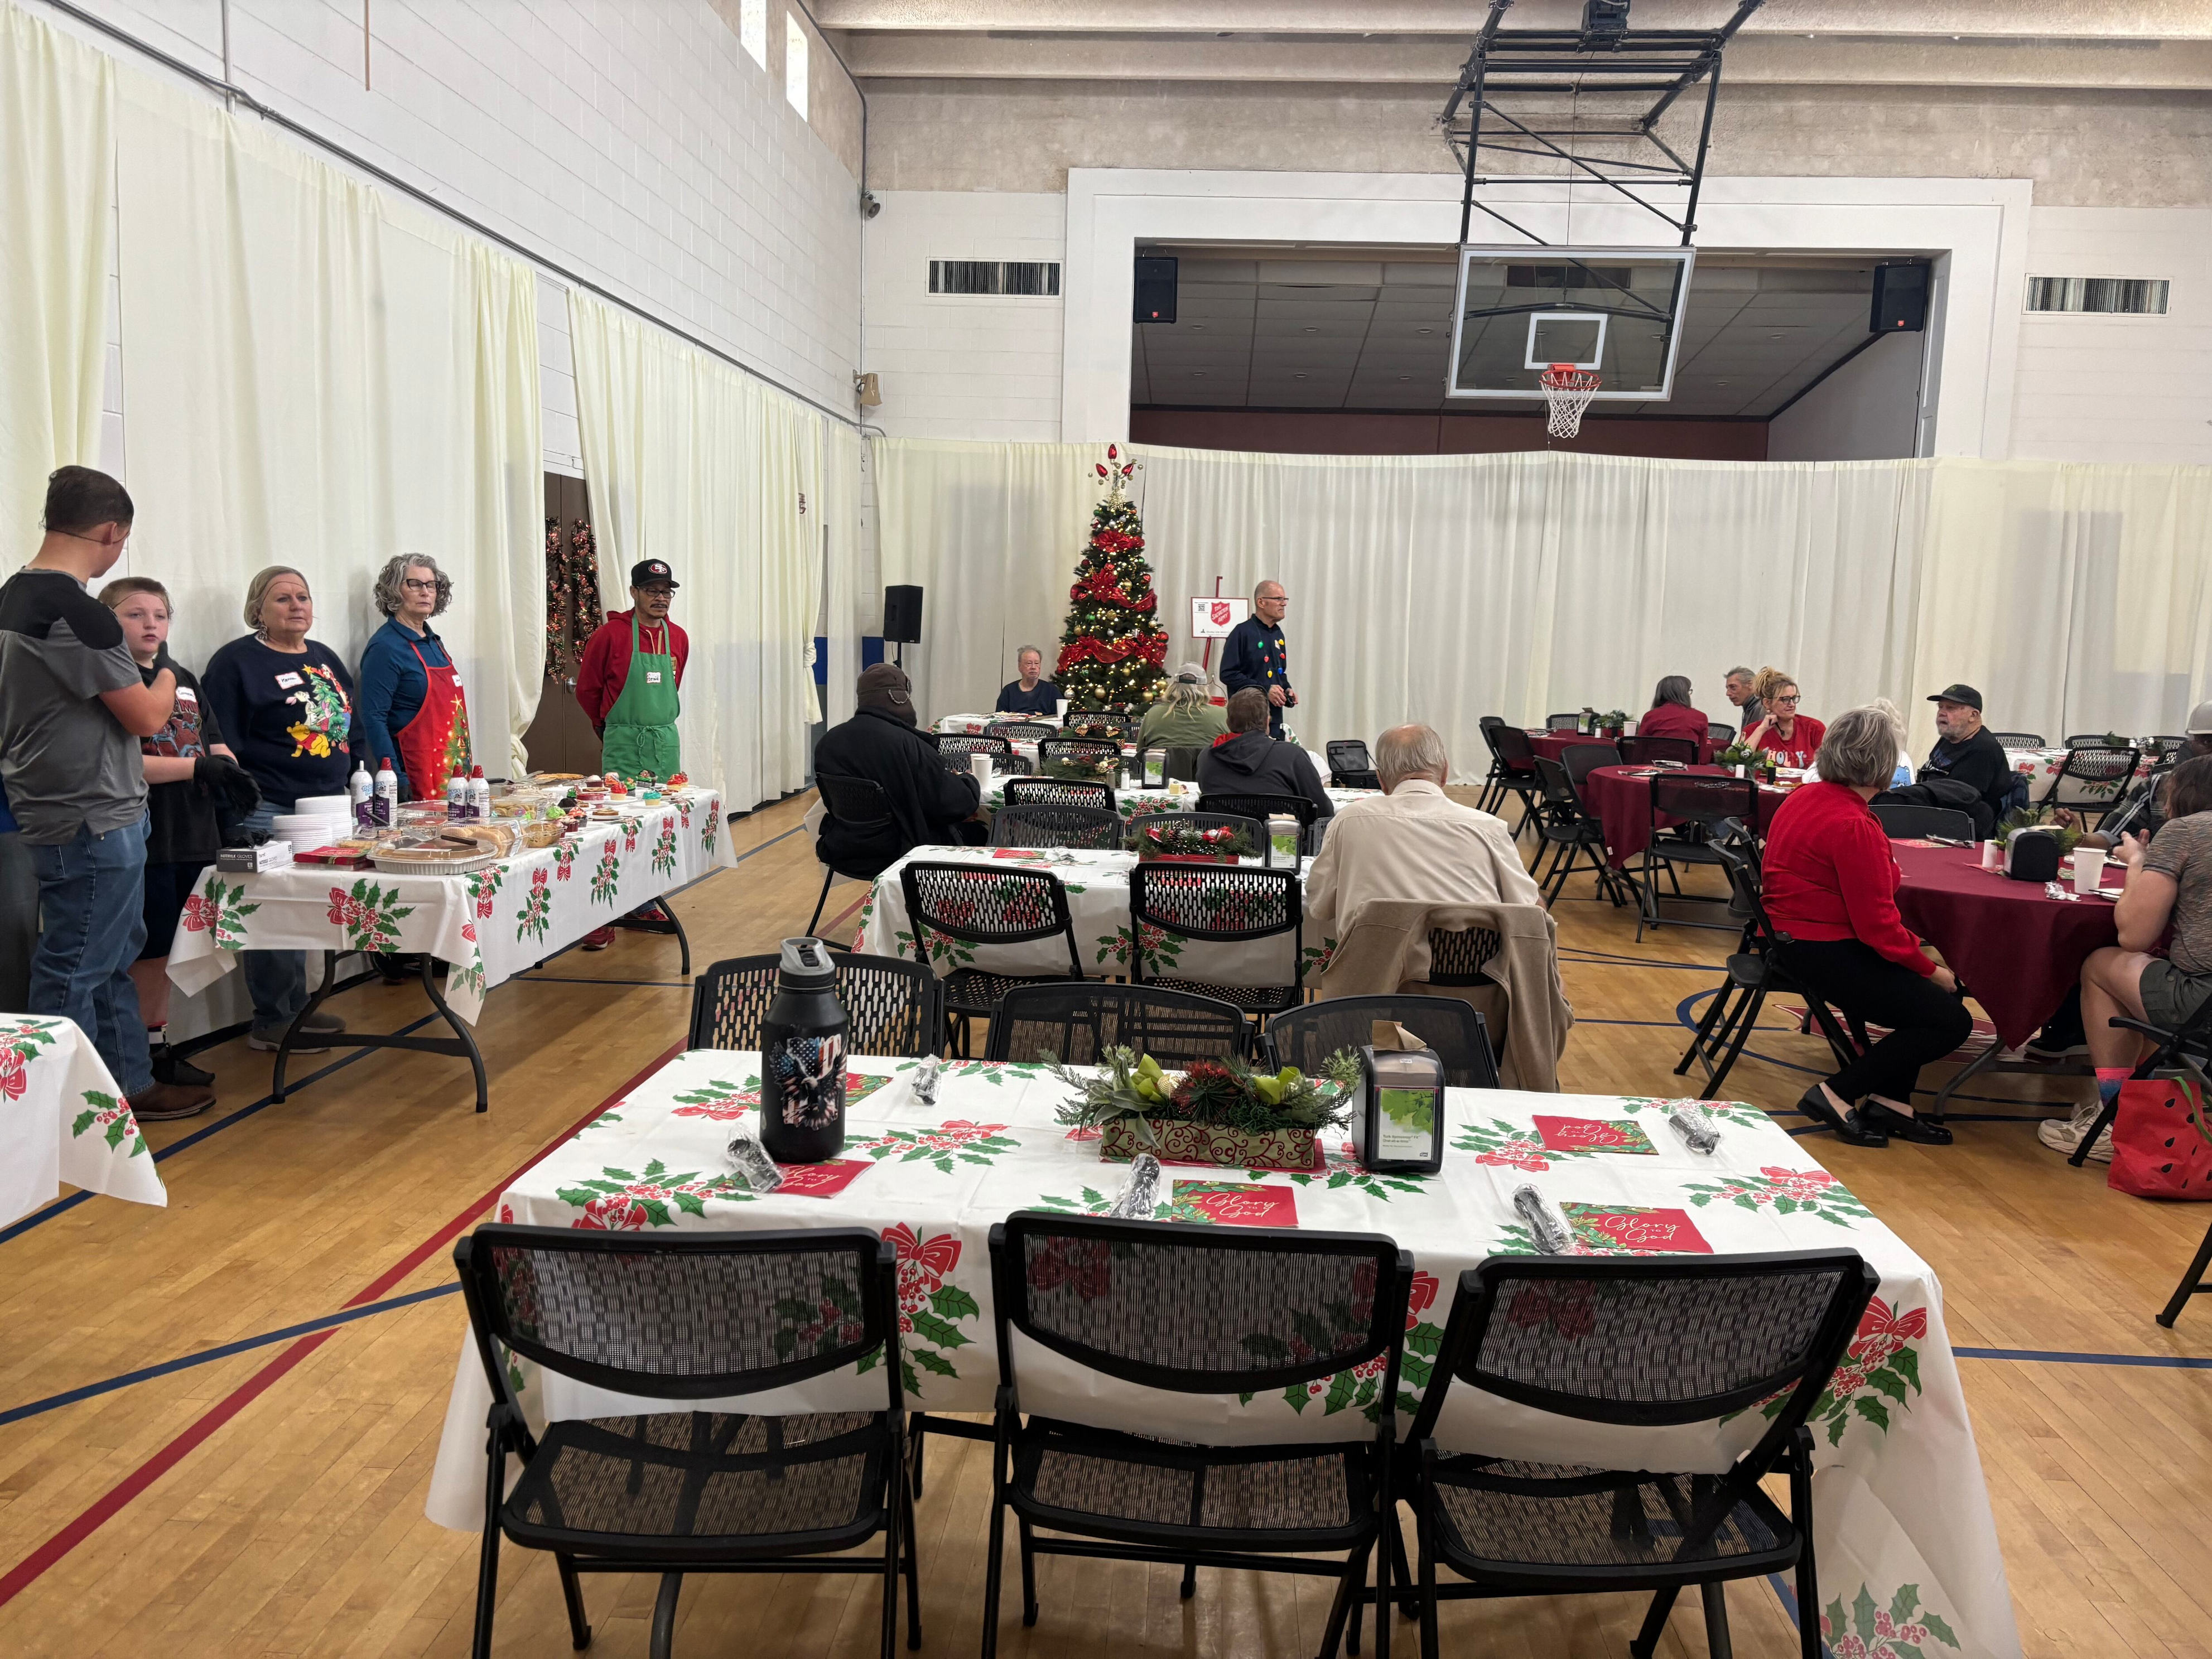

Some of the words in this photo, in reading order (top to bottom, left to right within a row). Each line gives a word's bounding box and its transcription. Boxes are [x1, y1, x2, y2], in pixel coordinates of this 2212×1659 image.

[1206, 1193, 1280, 1209] Glory
[1219, 1205, 1270, 1218] God
[1605, 1216, 1681, 1232] Glory
[1625, 1228, 1674, 1243] God
